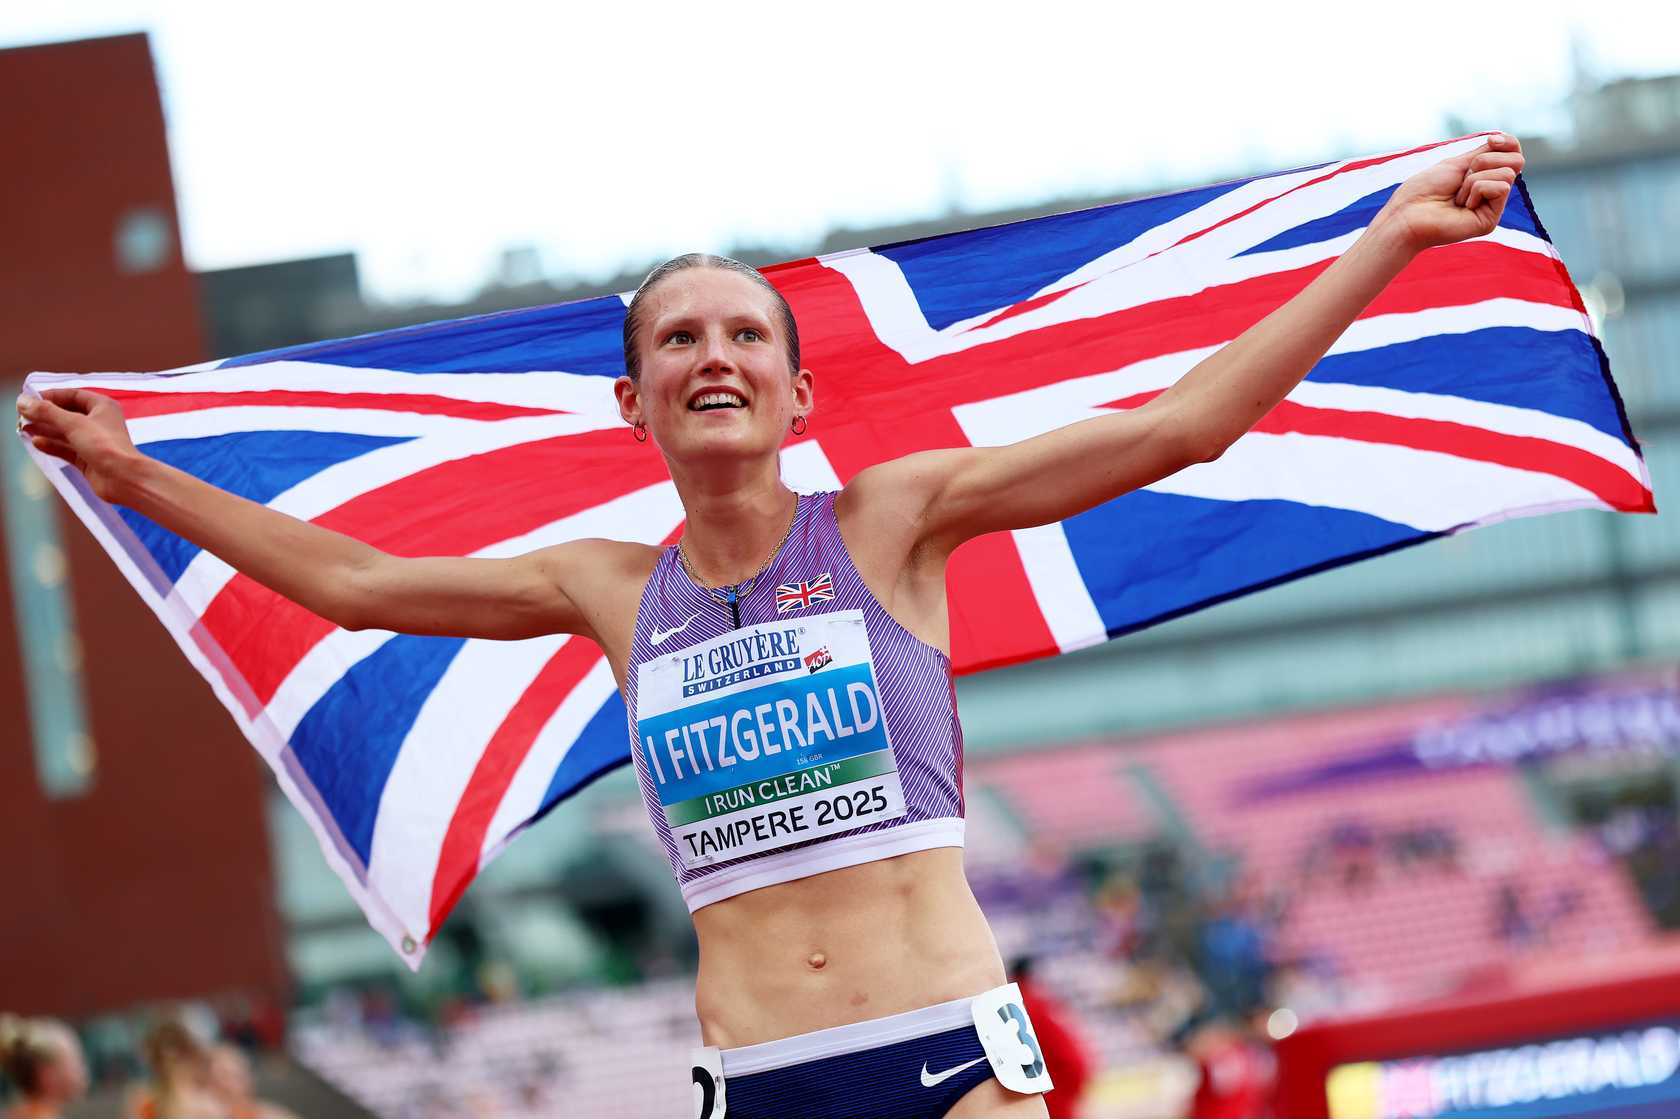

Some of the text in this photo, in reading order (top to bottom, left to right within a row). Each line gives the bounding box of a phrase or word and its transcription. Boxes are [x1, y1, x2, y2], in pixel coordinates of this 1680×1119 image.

[683, 653, 706, 683] LE
[688, 660, 796, 695] SWITZERLAND
[646, 681, 878, 785] I FITZGERALD
[683, 785, 888, 857] TAMPERE 2025
[704, 797, 713, 814] I
[715, 786, 756, 813] RUN
[996, 1002, 1044, 1079] 3
